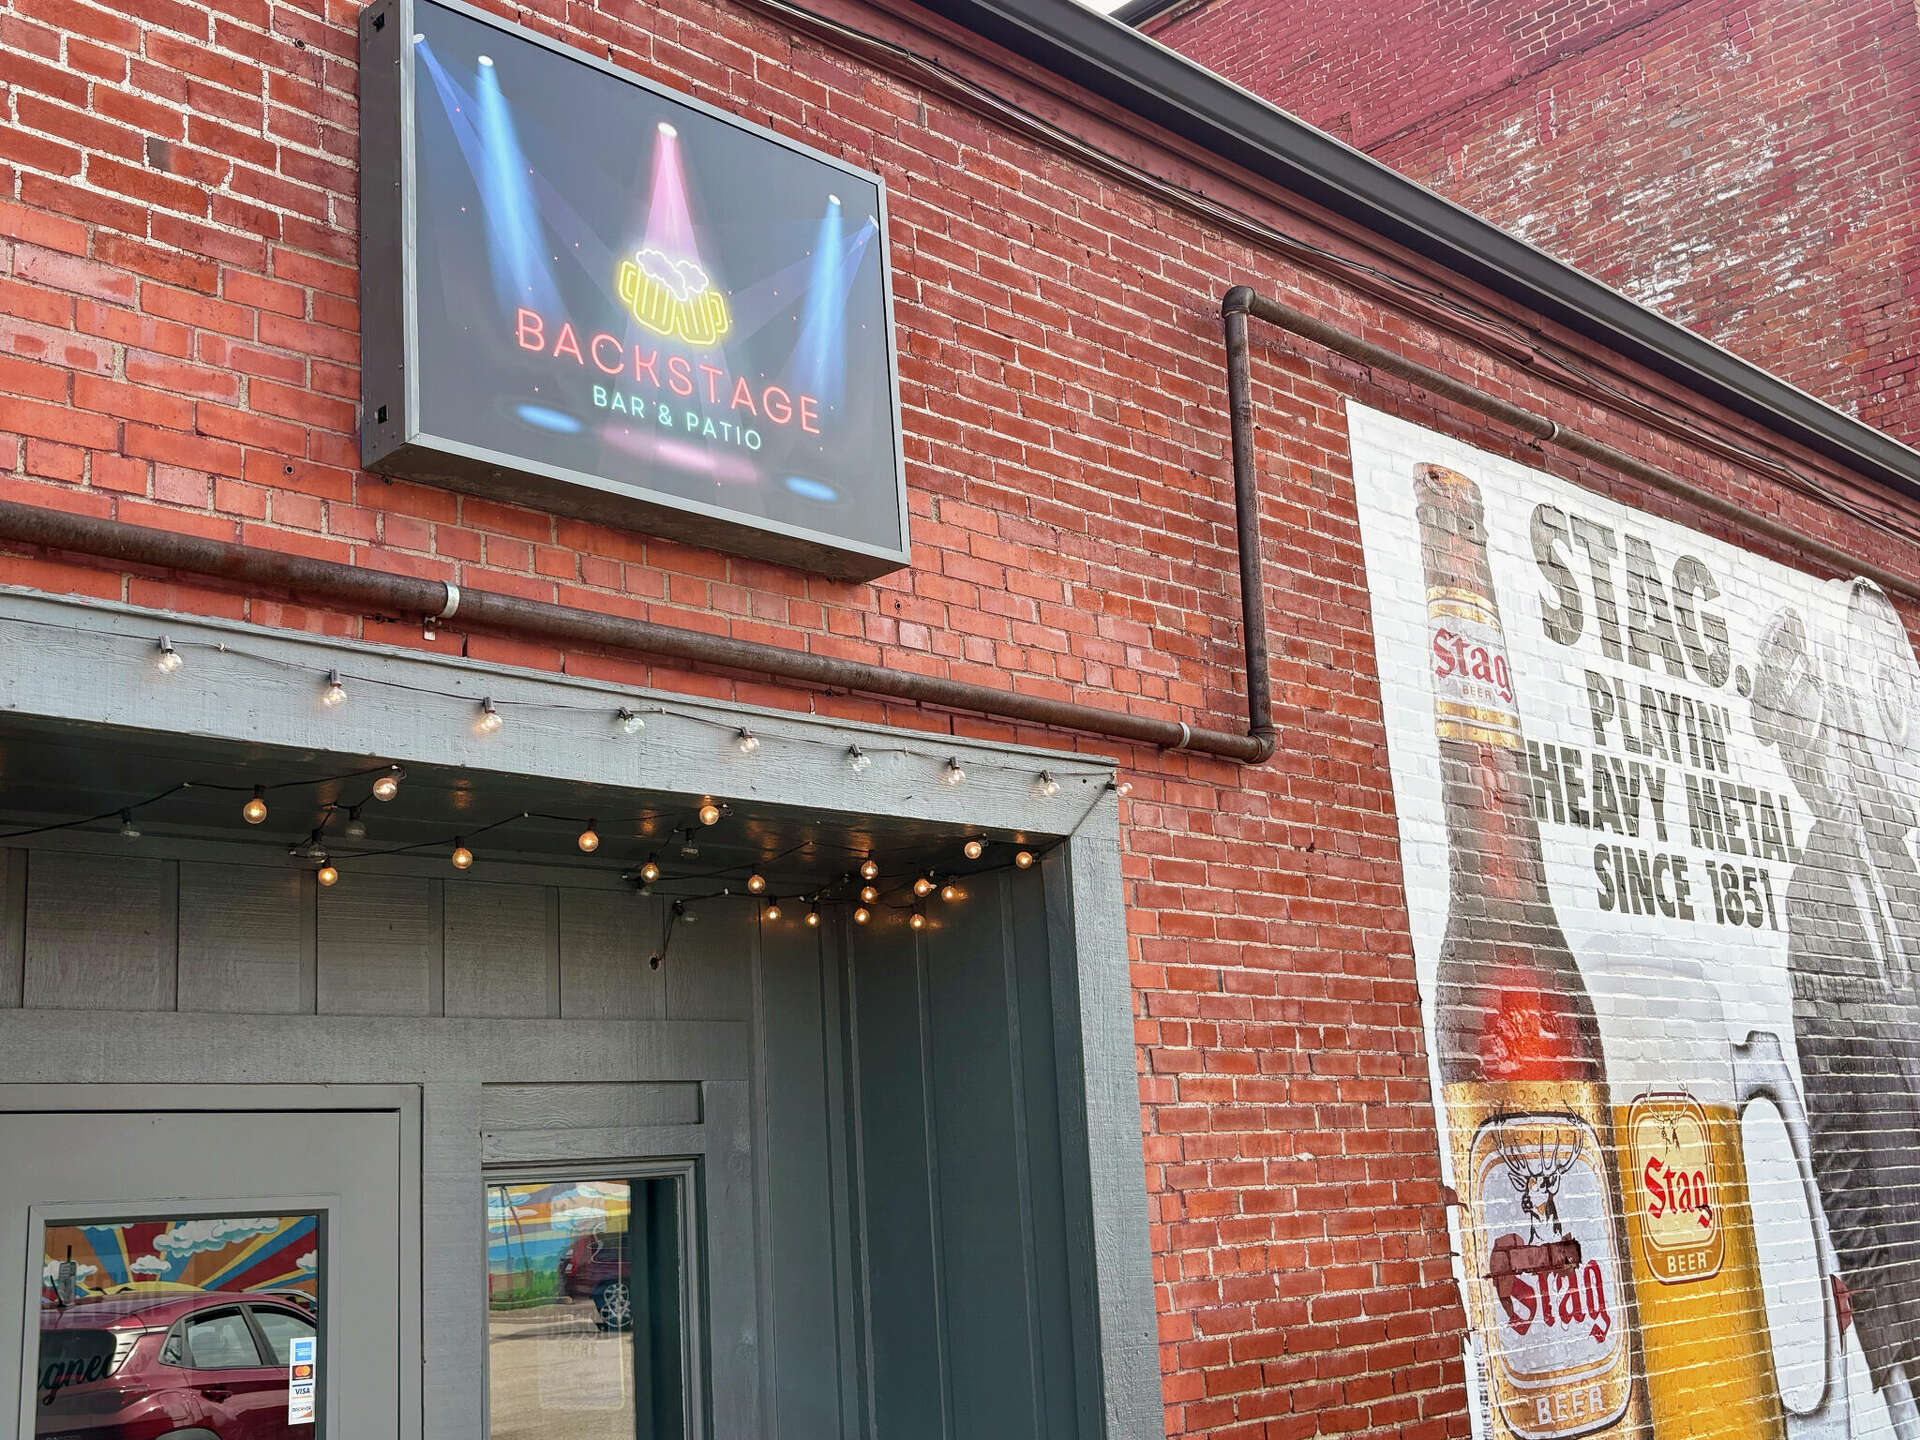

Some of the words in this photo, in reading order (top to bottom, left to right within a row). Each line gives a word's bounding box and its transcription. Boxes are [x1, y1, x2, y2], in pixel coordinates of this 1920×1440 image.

[515, 307, 820, 434] BACKSTAGE
[593, 384, 645, 418] BAR
[658, 404, 673, 427] &
[686, 411, 761, 450] PATIO
[1530, 503, 1751, 698] STAG.
[1433, 628, 1513, 703] Stag
[1462, 684, 1492, 701] BEER
[1584, 669, 1732, 774] PLAYIN'
[1527, 739, 1668, 842] HEAVY
[1685, 773, 1803, 863] METAL
[1593, 843, 1695, 921] SINCE
[1705, 860, 1778, 931] 1851
[1644, 1157, 1713, 1228] Stag
[1667, 1251, 1707, 1273] BEER
[295, 1387, 311, 1396] VISA
[1536, 1387, 1606, 1425] BEER
